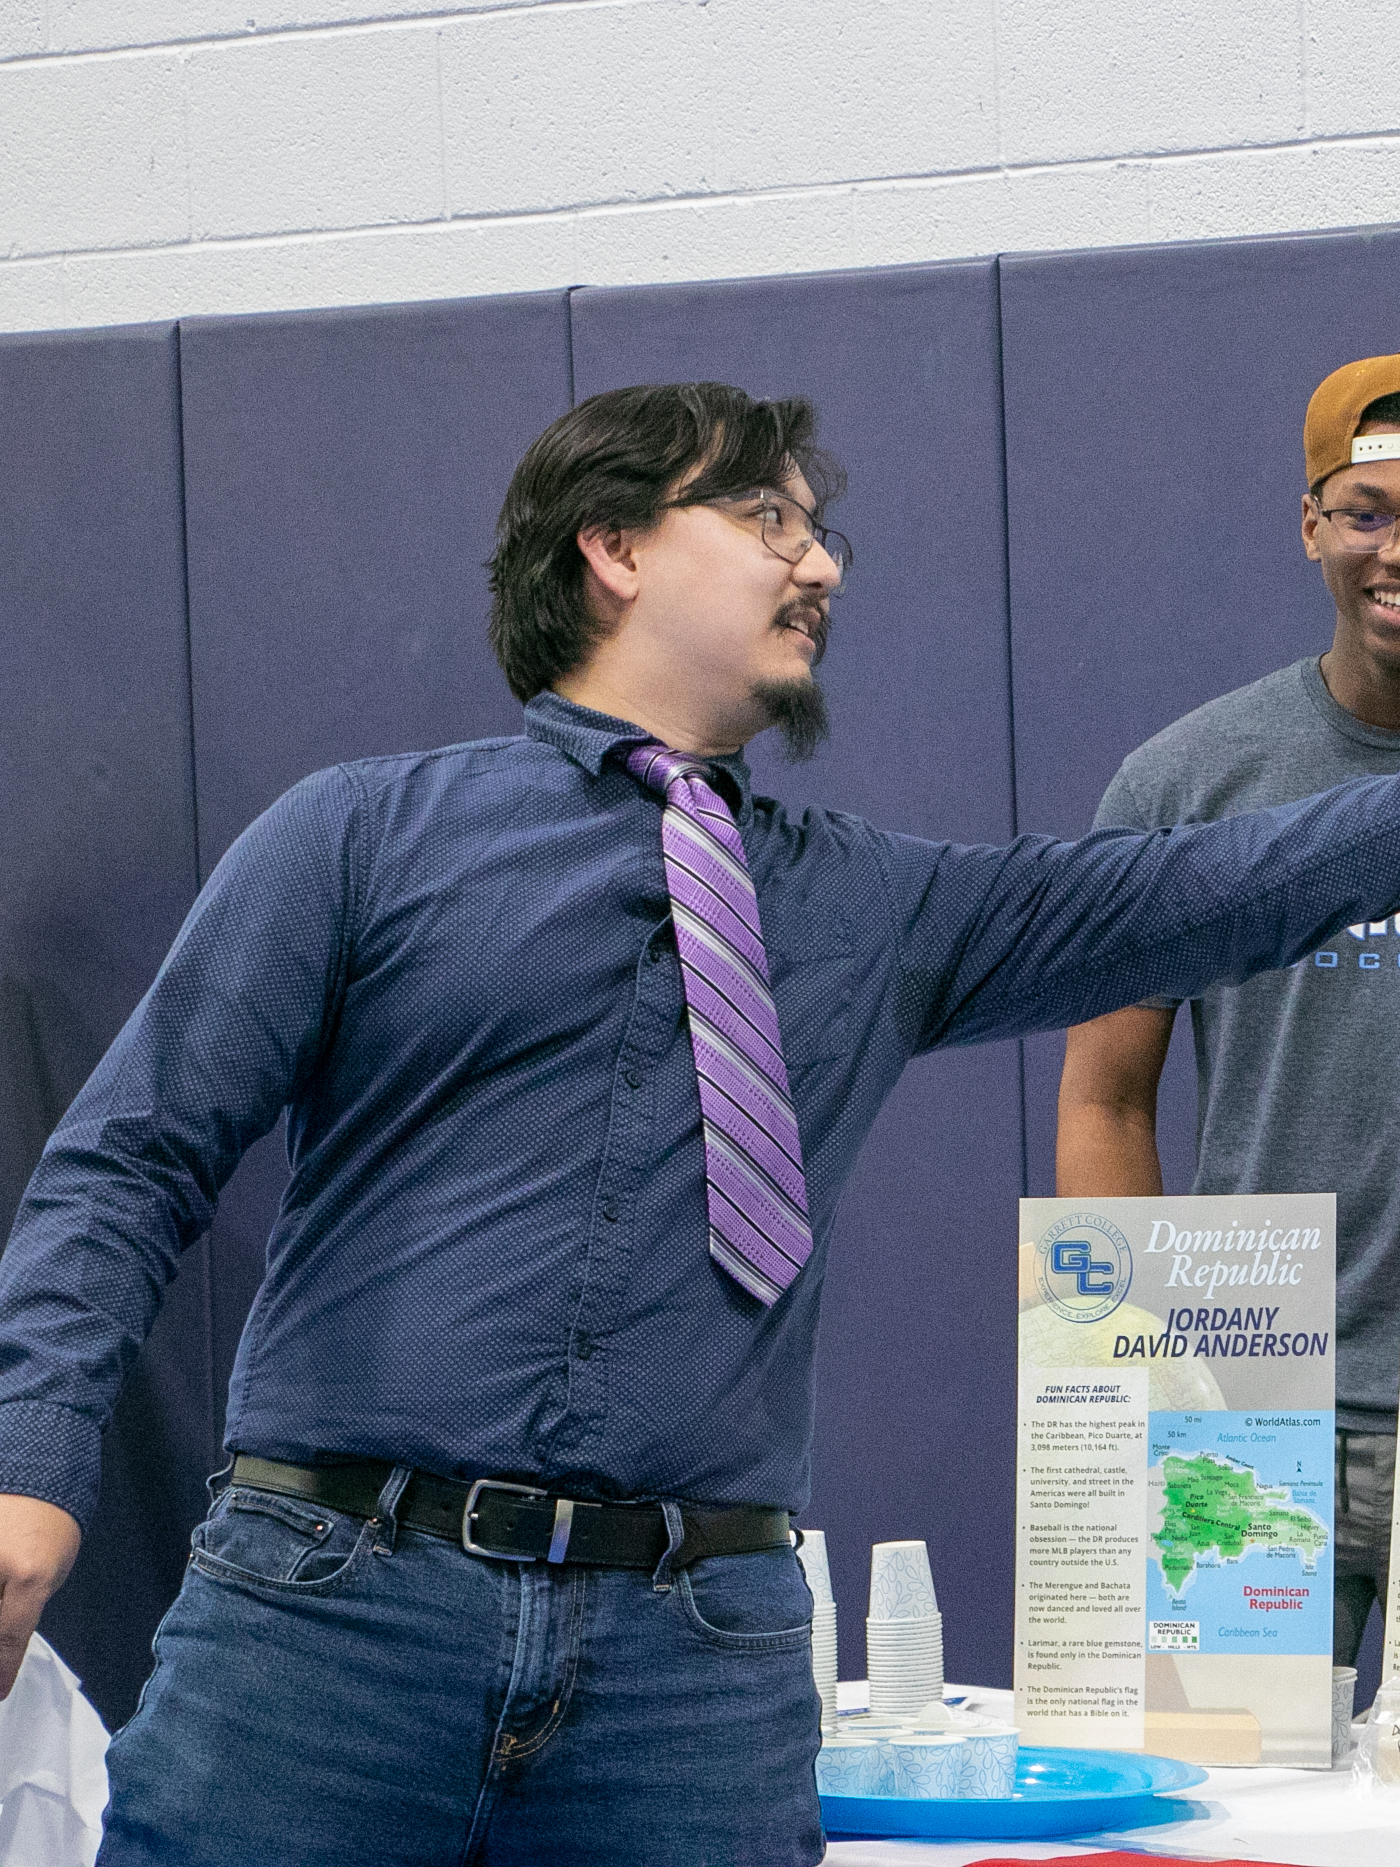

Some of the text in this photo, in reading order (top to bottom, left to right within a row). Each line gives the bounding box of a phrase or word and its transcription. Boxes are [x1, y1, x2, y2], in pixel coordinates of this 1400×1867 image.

[1038, 1214, 1127, 1254] GARRETT COLLEGE
[1143, 1220, 1322, 1254] Dominican
[1164, 1252, 1304, 1300] Republic
[1163, 1307, 1280, 1338] JORDANY
[1113, 1332, 1328, 1359] DAVID ANDERSON
[1045, 1385, 1121, 1394] FUN FACTS ABOUT
[1036, 1395, 1132, 1404] DOMINICAN REPUBLIC:
[1089, 1420, 1116, 1429] highest
[1118, 1420, 1135, 1429] peak
[1255, 1417, 1321, 1426] WorldAtlas.com
[1105, 1431, 1133, 1439] Duarte,
[1217, 1433, 1276, 1442] Atlantic Ocean
[1108, 1443, 1119, 1451] ft).
[1063, 1466, 1102, 1474] cathedral,
[1030, 1478, 1070, 1486] university,
[1121, 1477, 1134, 1485] the
[1030, 1489, 1065, 1497] Americas
[1030, 1500, 1089, 1510] Santo Domingo!
[1241, 1530, 1278, 1538] Domingo
[1104, 1535, 1138, 1544] produces
[1069, 1547, 1096, 1556] players
[1118, 1548, 1131, 1556] any
[1029, 1559, 1059, 1567] country
[1105, 1558, 1119, 1566] U.S.
[1029, 1581, 1042, 1589] The
[1044, 1581, 1082, 1591] Merengue
[1243, 1586, 1310, 1597] Dominican
[1028, 1593, 1068, 1602] originated
[1250, 1599, 1303, 1612] Republic
[1218, 1627, 1278, 1638] Caribbean Sea
[1086, 1639, 1102, 1647] blue
[1104, 1640, 1143, 1649] gemstone,
[1035, 1650, 1058, 1658] found
[1060, 1651, 1076, 1660] only
[1102, 1651, 1141, 1659] Dominican
[1027, 1662, 1061, 1671] Republic.
[1027, 1685, 1041, 1693] The
[1043, 1685, 1083, 1693] Dominican
[1124, 1686, 1138, 1695] flag
[1049, 1697, 1066, 1706] only
[1101, 1697, 1115, 1707] flag
[1026, 1708, 1048, 1716] world
